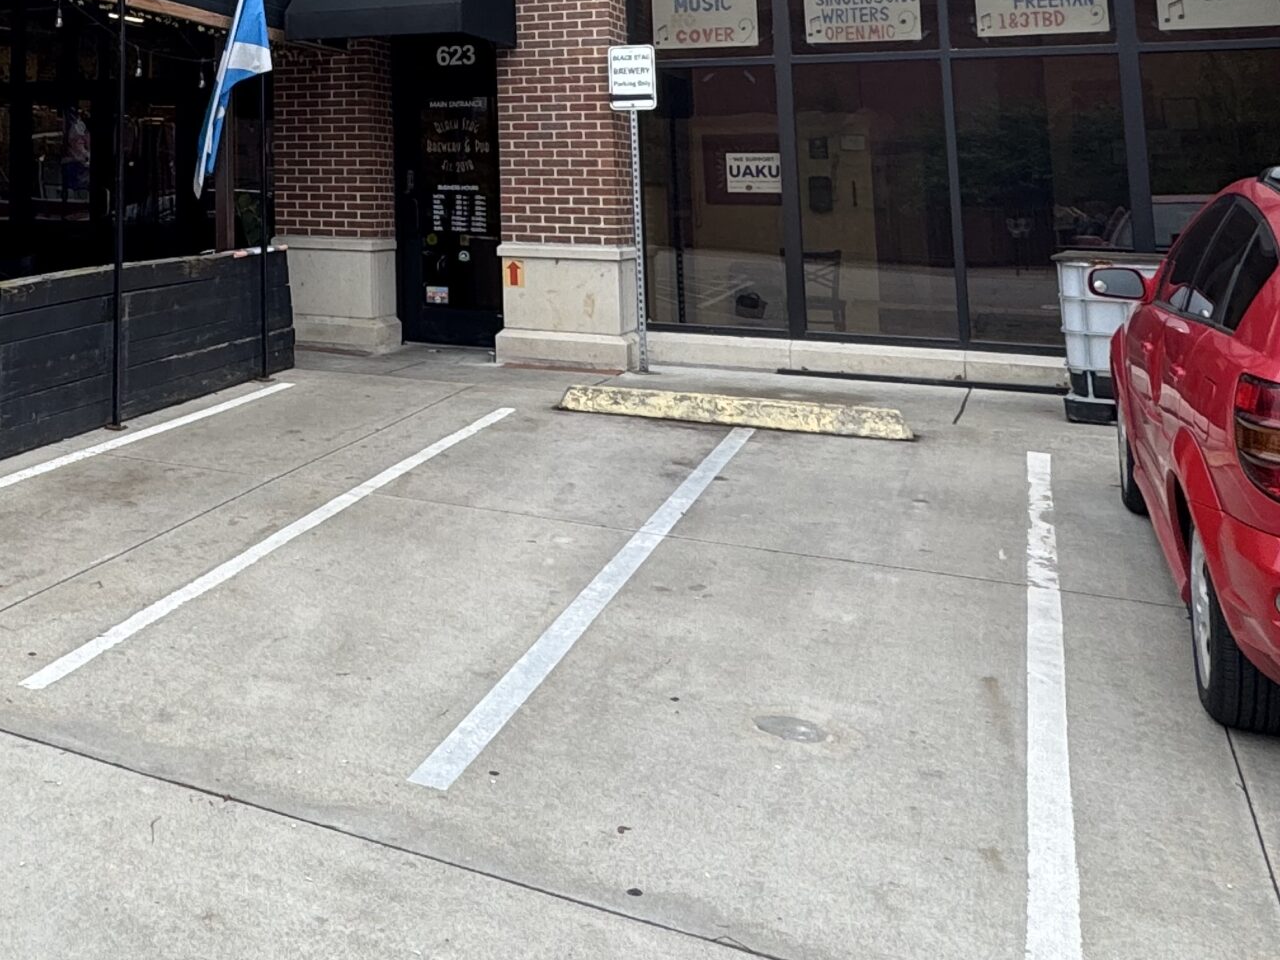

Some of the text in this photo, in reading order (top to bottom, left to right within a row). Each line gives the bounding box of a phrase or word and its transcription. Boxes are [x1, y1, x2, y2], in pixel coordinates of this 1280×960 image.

[821, 7, 889, 24] WRITERS
[1030, 10, 1065, 28] TBD
[676, 27, 735, 43] COVER
[825, 24, 896, 40] OPEN MIC
[436, 44, 476, 66] 623
[613, 67, 650, 75] BREWERY
[429, 100, 447, 108] MAIN
[729, 164, 780, 178] UAKU
